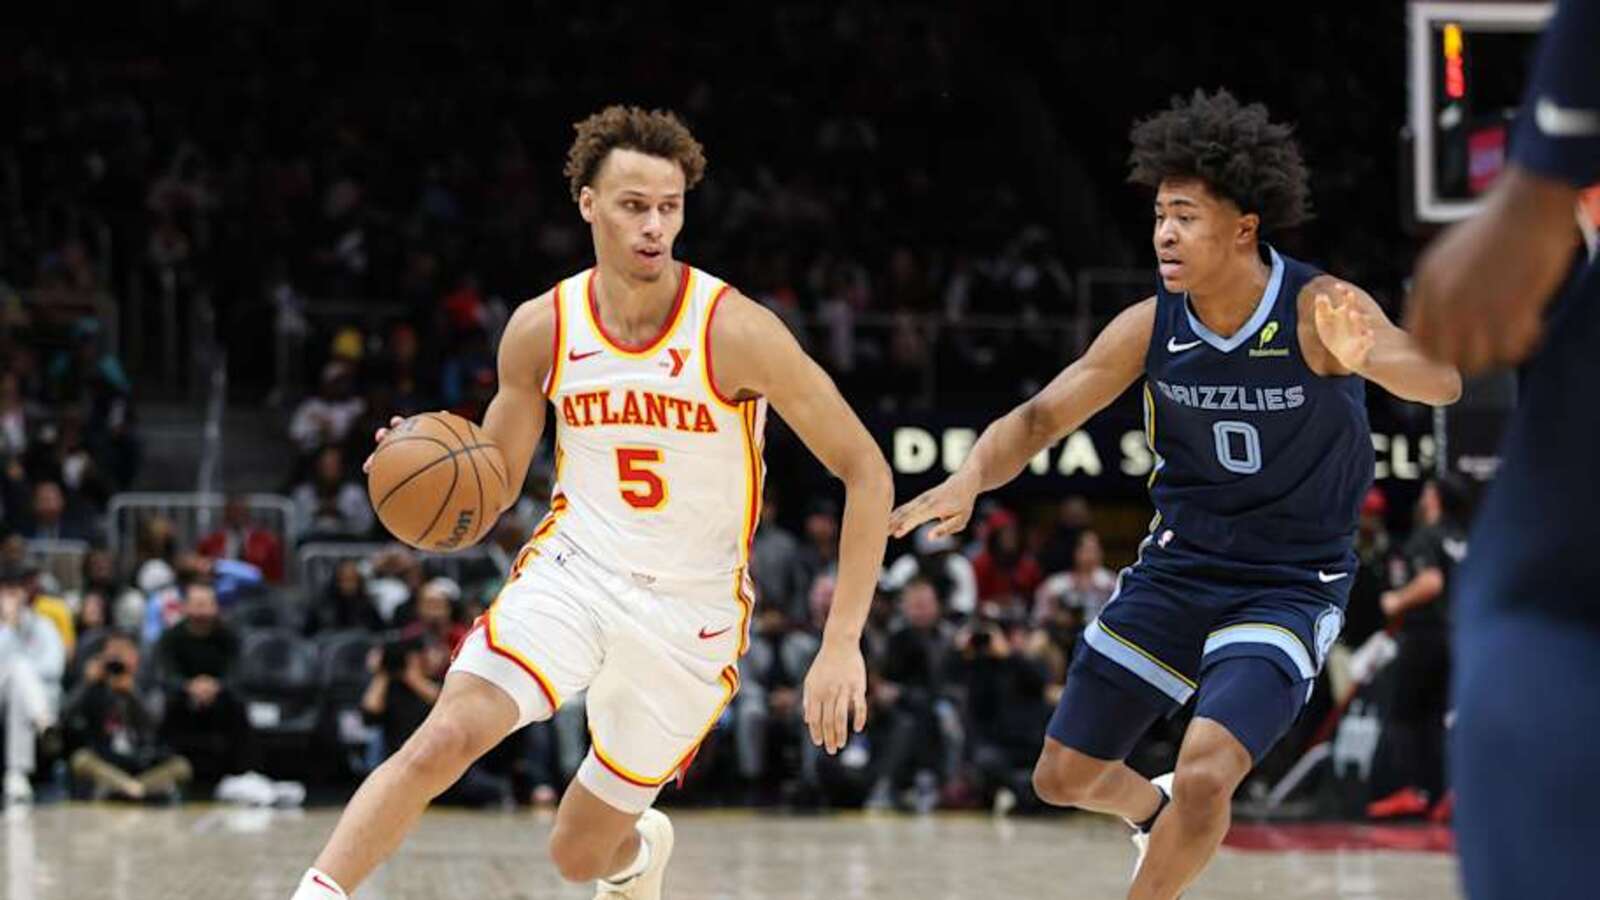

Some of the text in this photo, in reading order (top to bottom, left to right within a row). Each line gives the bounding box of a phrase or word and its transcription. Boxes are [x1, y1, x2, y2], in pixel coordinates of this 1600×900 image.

[562, 389, 719, 433] ATLANTA
[893, 426, 1102, 477] DEA
[1212, 419, 1263, 475] 0
[614, 446, 669, 511] 5
